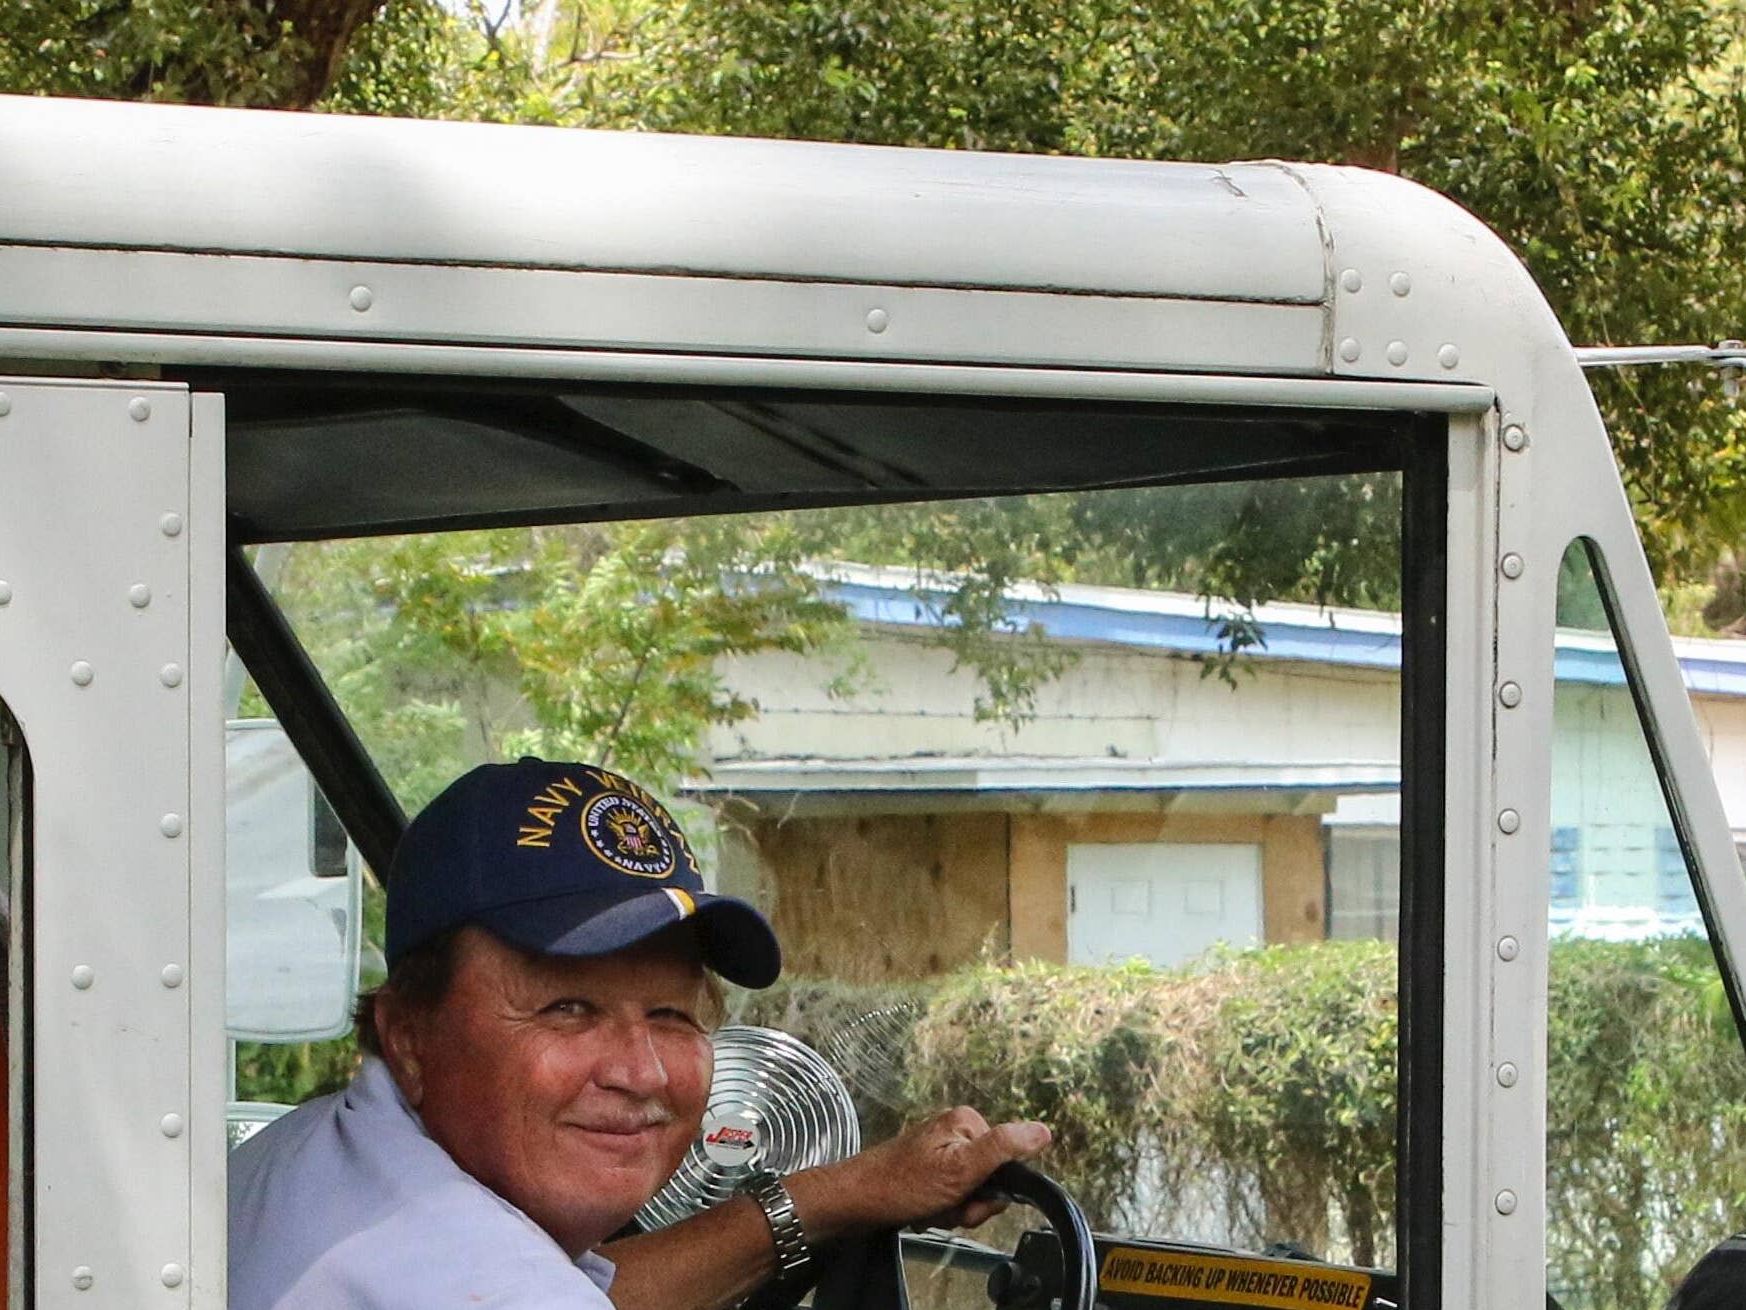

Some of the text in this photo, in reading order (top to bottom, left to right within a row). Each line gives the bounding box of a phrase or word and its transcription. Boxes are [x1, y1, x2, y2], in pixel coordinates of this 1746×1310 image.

[516, 776, 583, 848] NAVY
[587, 795, 620, 827] UNITED
[622, 858, 662, 873] NAVY
[1103, 1256, 1365, 1309] AVOID BACKING UP WHENEVER POSSIBLE
